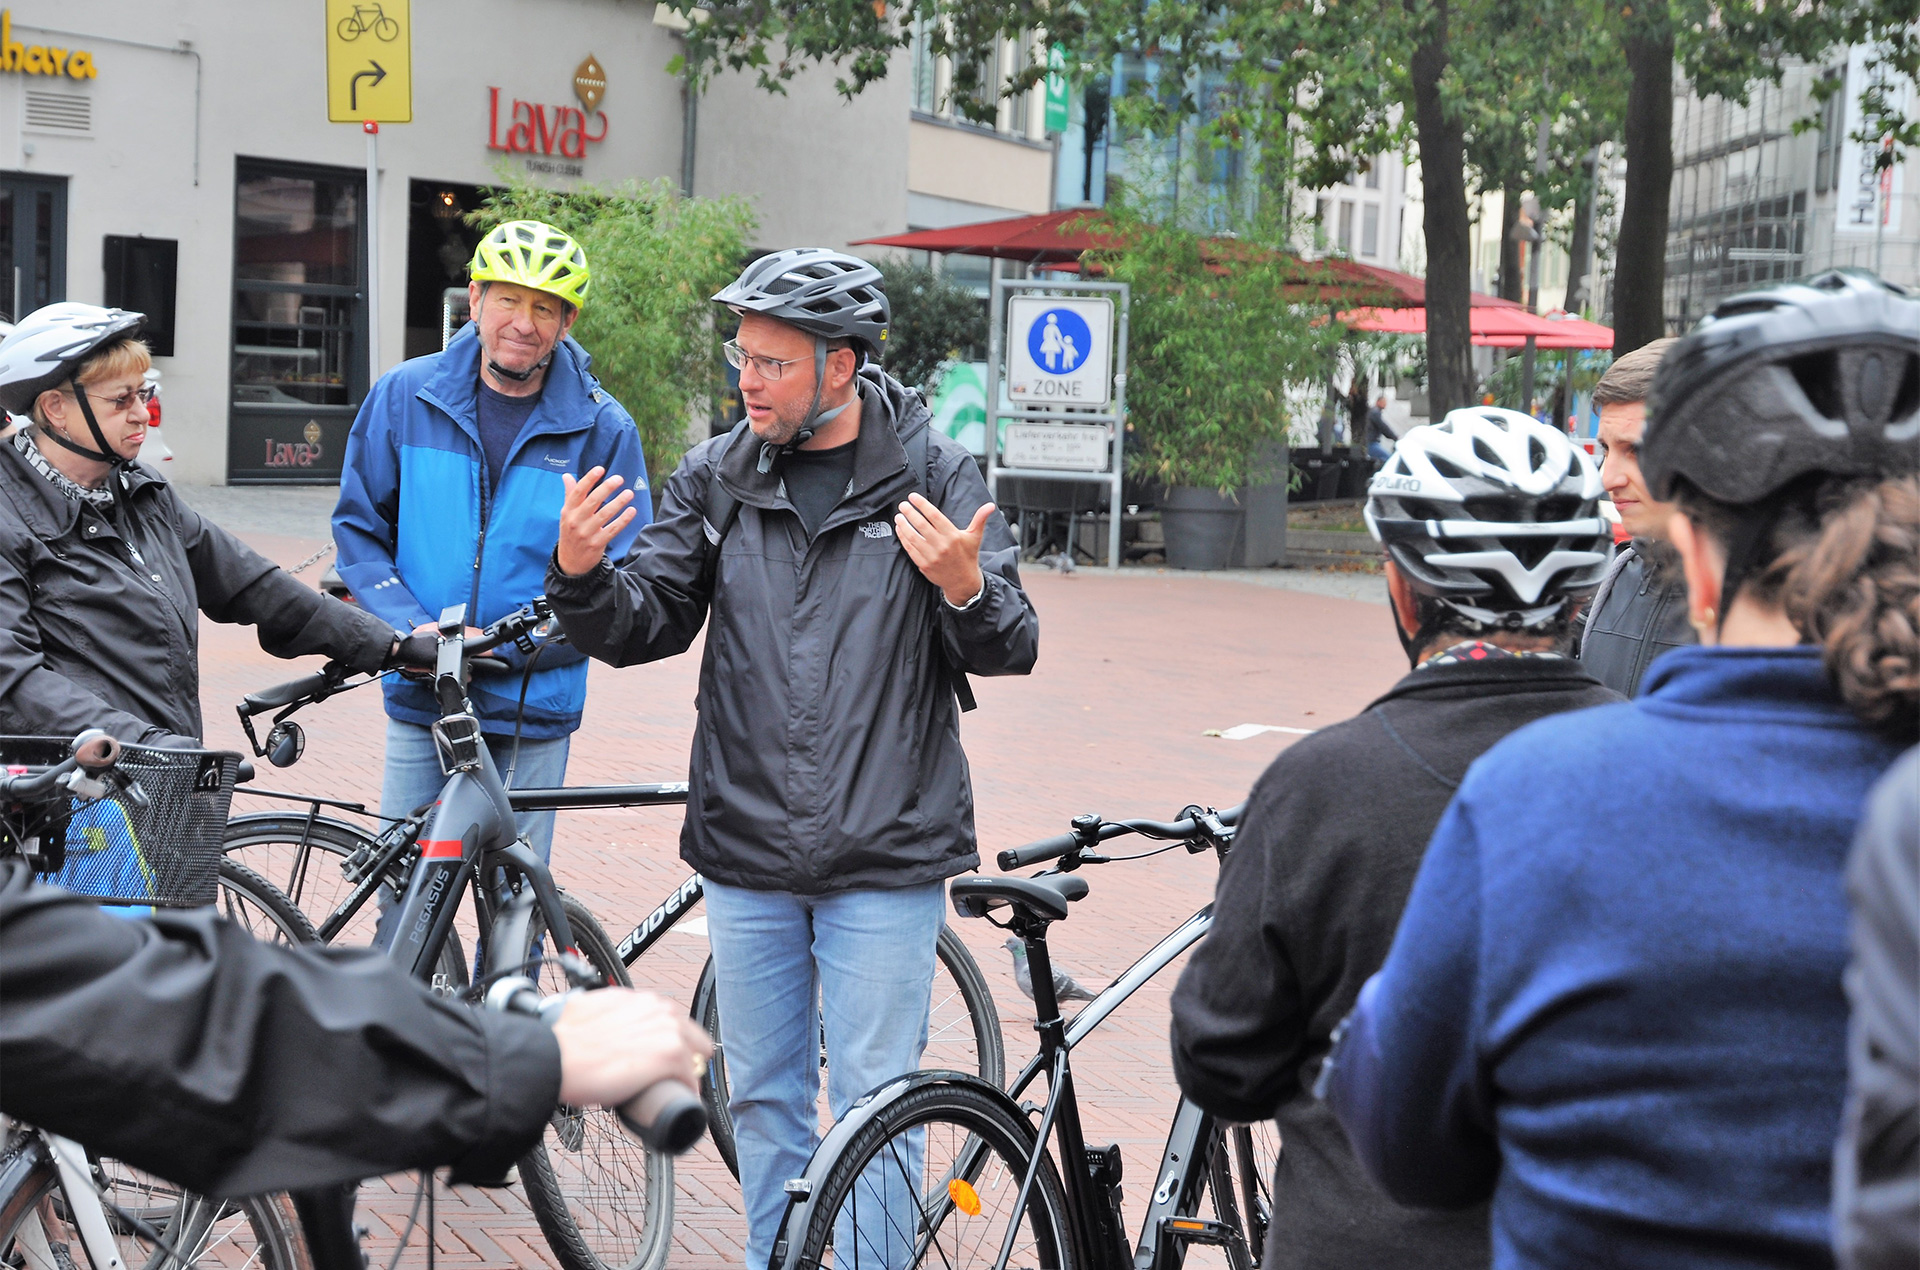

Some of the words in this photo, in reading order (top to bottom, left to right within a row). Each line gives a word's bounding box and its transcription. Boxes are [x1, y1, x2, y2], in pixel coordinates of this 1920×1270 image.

[0, 7, 98, 79] hara
[487, 86, 608, 159] Lava
[1033, 379, 1082, 396] ZONE
[264, 438, 322, 468] Lava
[409, 868, 450, 944] PEGASUS
